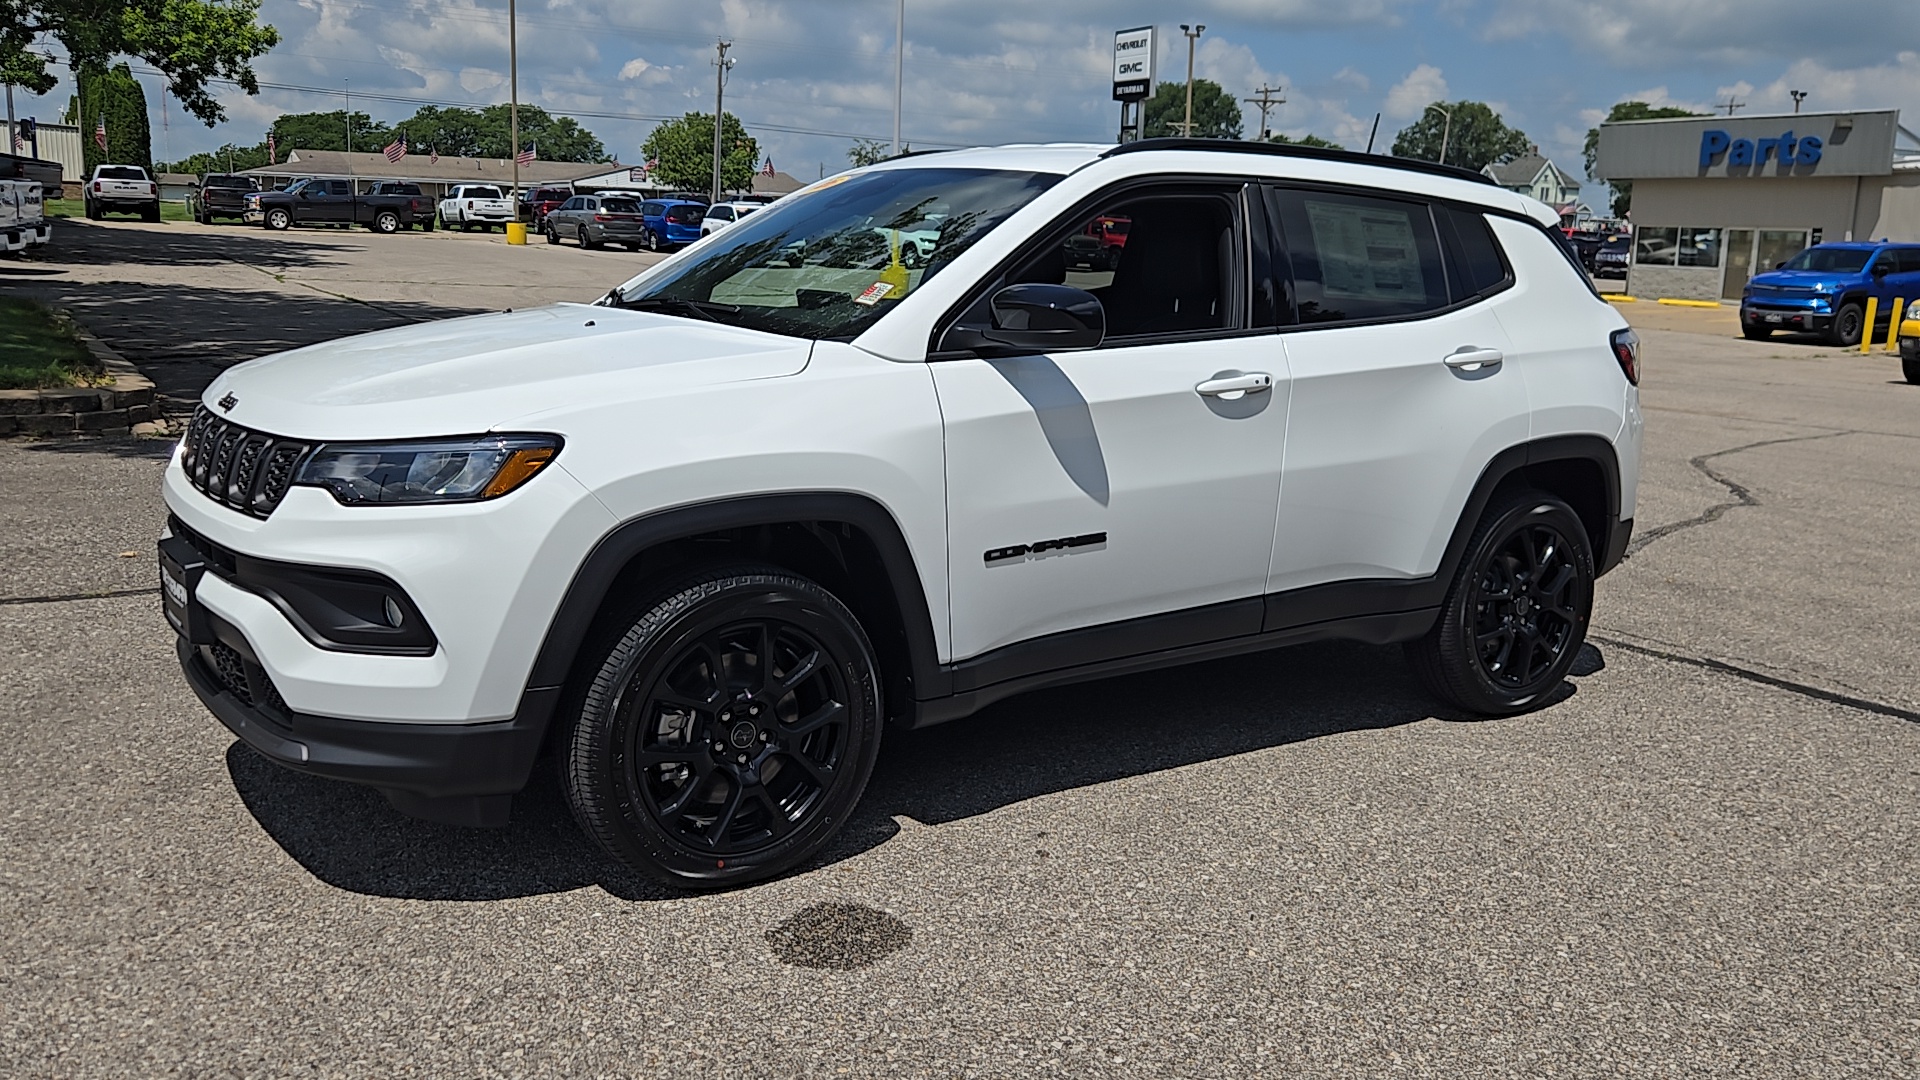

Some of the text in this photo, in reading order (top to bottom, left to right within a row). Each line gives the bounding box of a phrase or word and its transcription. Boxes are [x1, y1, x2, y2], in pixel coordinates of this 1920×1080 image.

[1116, 38, 1147, 51] CHEVROLET
[1119, 61, 1143, 74] GMC
[1699, 129, 1823, 167] Parts
[983, 531, 1107, 562] COMPASS
